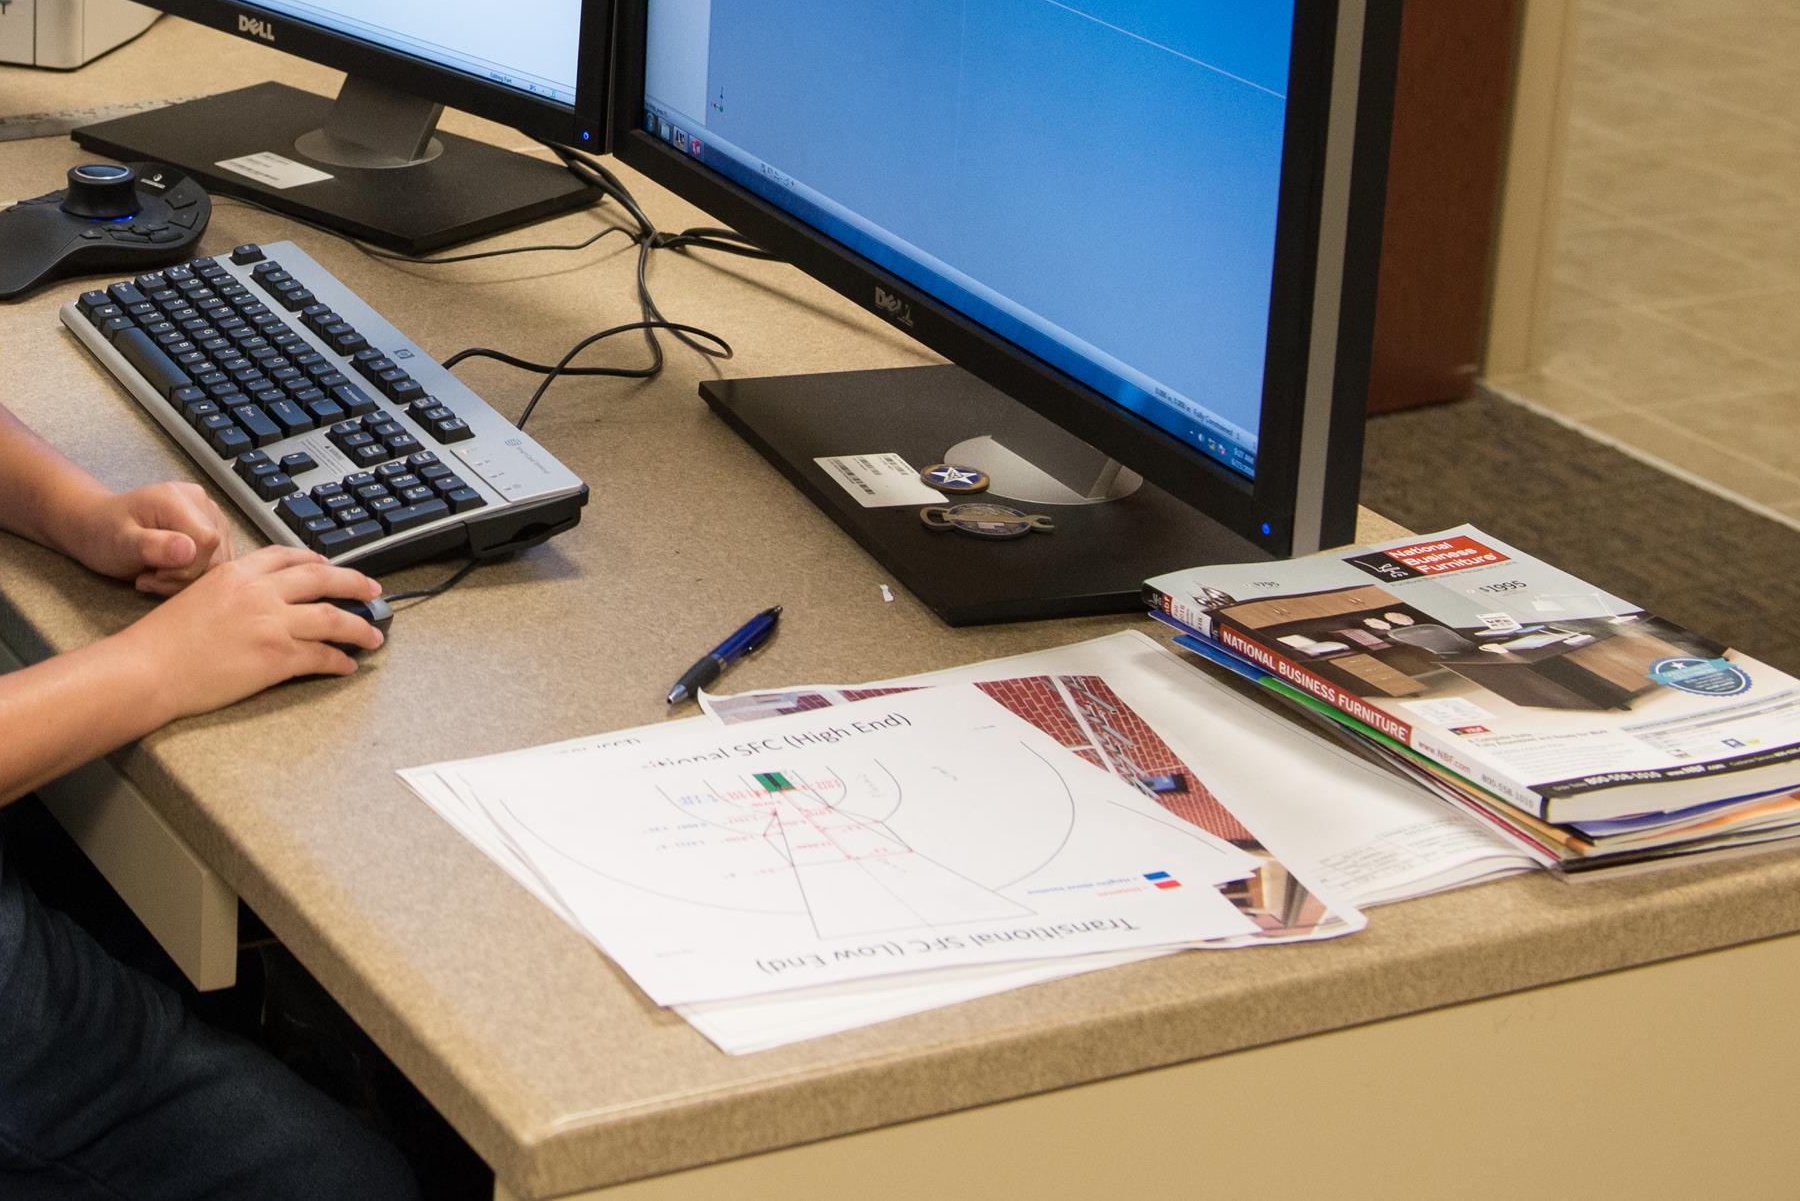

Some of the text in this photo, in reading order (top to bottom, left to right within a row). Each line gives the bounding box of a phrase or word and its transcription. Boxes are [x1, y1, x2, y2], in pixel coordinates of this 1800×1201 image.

[239, 14, 275, 41] DELL
[1388, 542, 1453, 559] National
[1403, 548, 1478, 567] Business
[1417, 553, 1497, 574] Furniture
[1223, 631, 1408, 742] NATIONAL BUSINESS FURNITURE
[734, 738, 783, 758] SFC
[783, 726, 851, 749] (High
[852, 711, 913, 735] End)
[1418, 741, 1471, 775] www.NBF.com
[918, 933, 967, 954] SFC
[973, 917, 1141, 949] Transitional
[757, 954, 825, 976] End)
